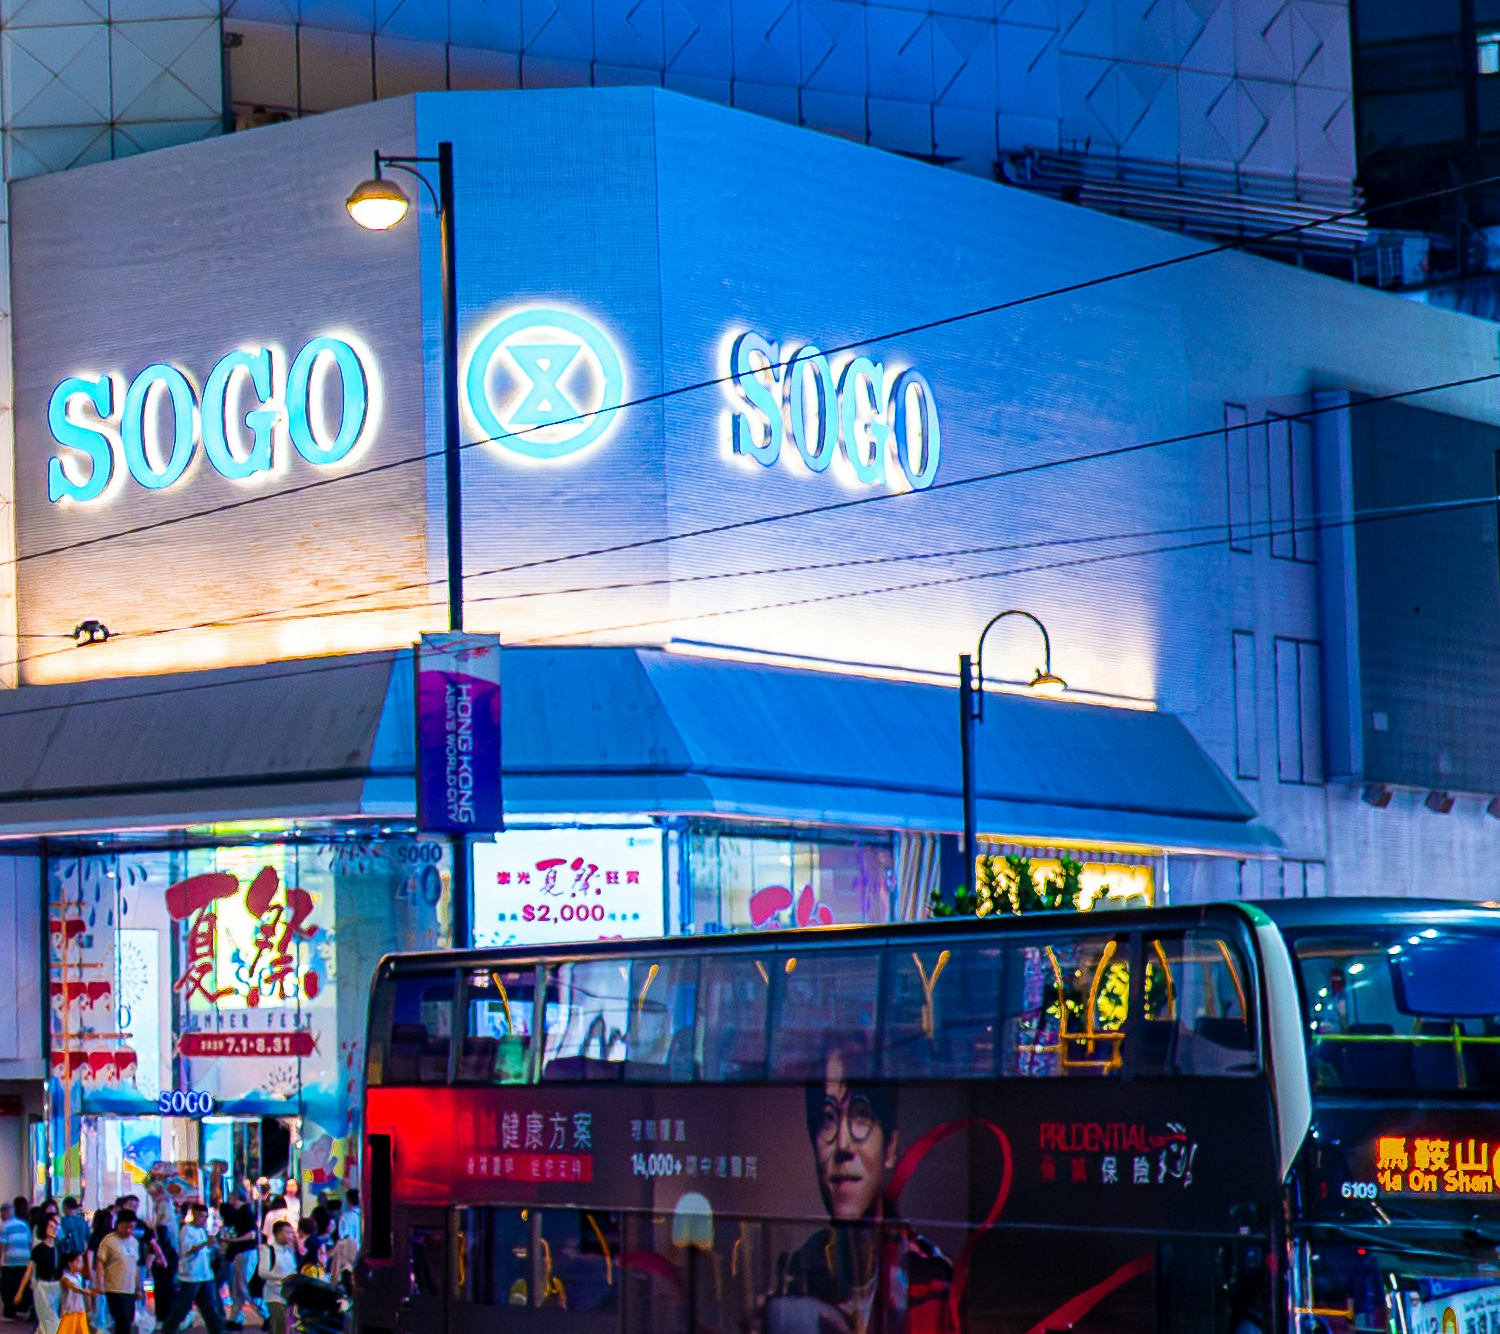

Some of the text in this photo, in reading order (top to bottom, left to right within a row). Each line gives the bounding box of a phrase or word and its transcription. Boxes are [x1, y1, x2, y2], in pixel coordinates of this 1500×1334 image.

[48, 335, 369, 502] SOGO
[733, 331, 941, 490] SOGO
[446, 735, 457, 786] WORLD
[457, 683, 475, 824] HONG KONG
[522, 905, 605, 923] $2,000
[159, 1091, 213, 1114] SOGO
[501, 1112, 593, 1150] 健康方案
[1040, 1123, 1151, 1152] PRUDENTIAL
[1377, 1136, 1489, 1172] 馬鞍山
[1341, 1182, 1377, 1199] 6109
[1409, 1170, 1493, 1192] On Shan
